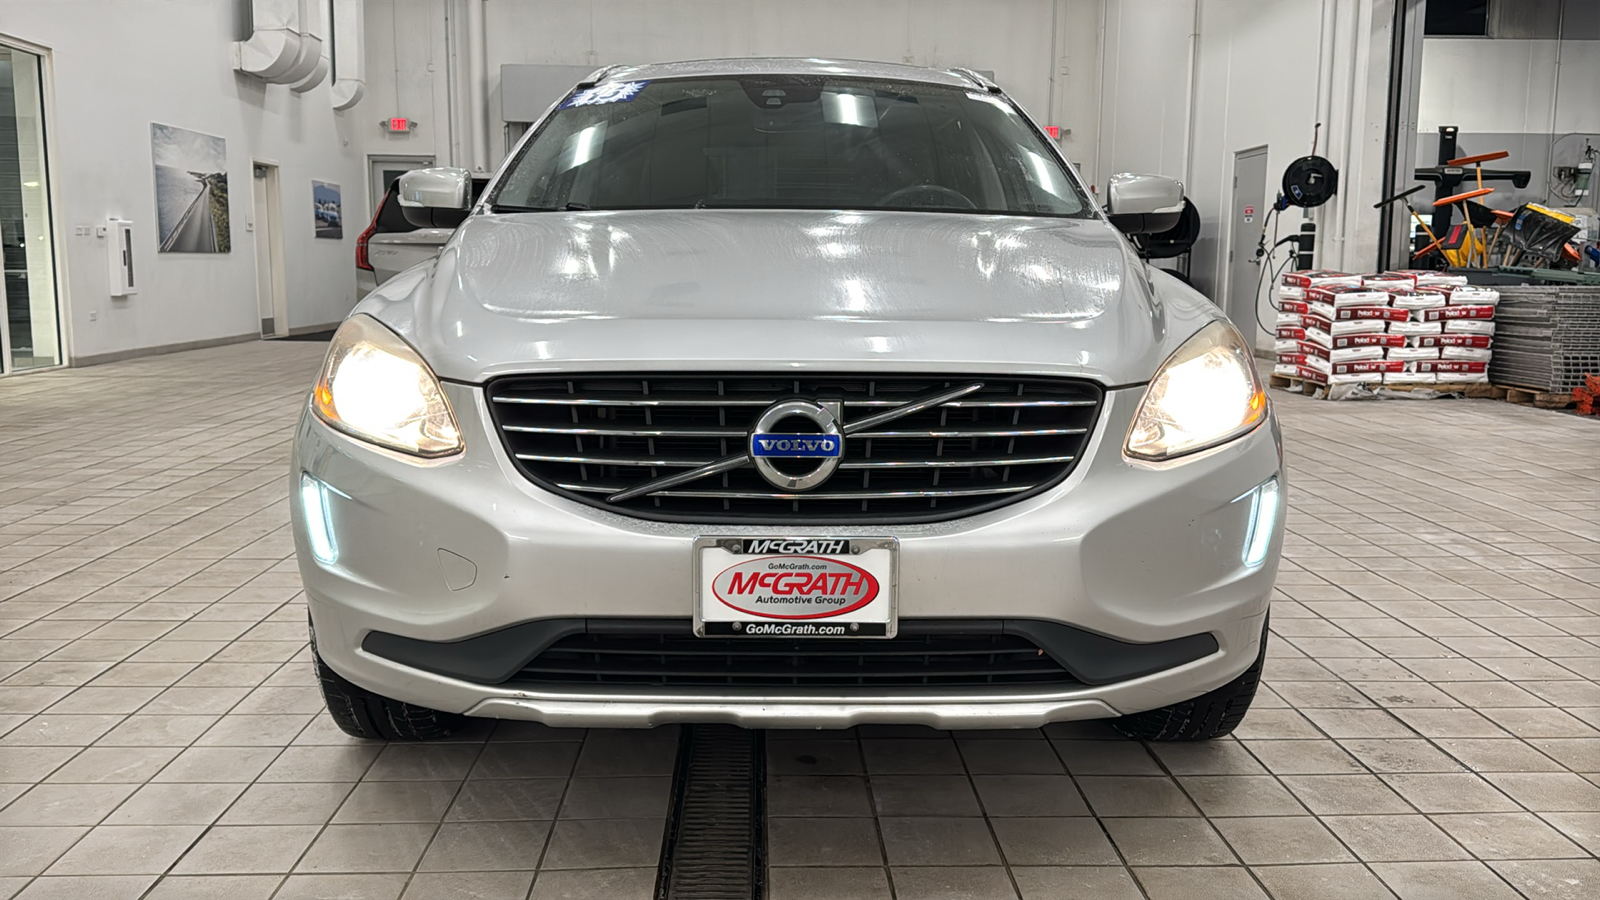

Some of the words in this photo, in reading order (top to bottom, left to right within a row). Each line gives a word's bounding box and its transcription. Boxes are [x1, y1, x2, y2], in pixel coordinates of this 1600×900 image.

[391, 118, 407, 130] EXIT
[758, 439, 835, 452] VOLVO
[768, 562, 827, 570] GoMcGrath.com
[755, 595, 812, 604] Automotive
[815, 596, 846, 605] Group
[745, 623, 845, 635] GoMcGrath.com
